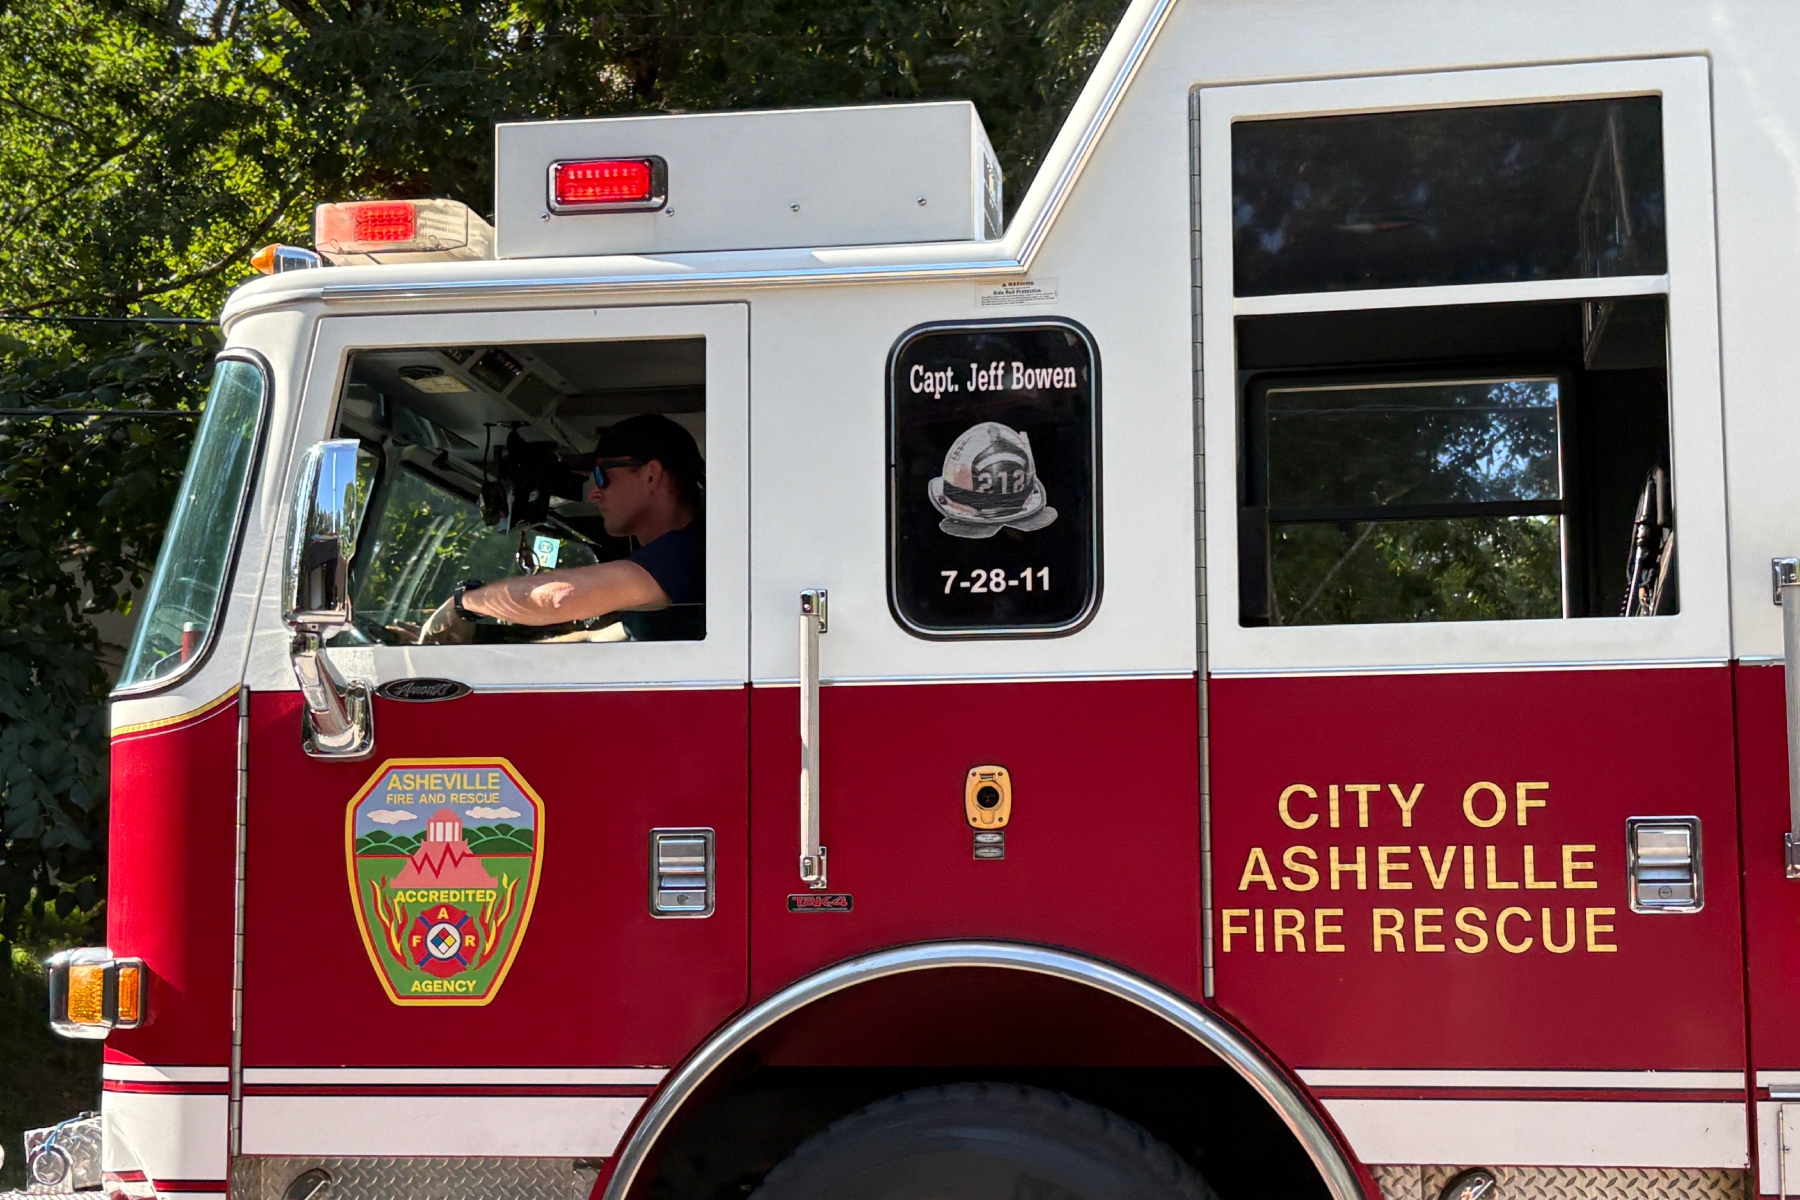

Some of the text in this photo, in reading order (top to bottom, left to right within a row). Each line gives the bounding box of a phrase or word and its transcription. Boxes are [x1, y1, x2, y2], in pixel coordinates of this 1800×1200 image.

[909, 361, 1077, 400] Capt. Jeff Bowen
[940, 566, 1050, 595] 7-28-11
[387, 773, 501, 791] ASHEVILLE
[386, 792, 500, 805] FIRE AND RESCUE
[1278, 781, 1550, 830] CITY OF
[1238, 844, 1598, 892] ASHEVILLE
[395, 889, 497, 904] ACCREDITED
[438, 907, 449, 919] A
[1221, 907, 1618, 954] FIRE RESCUE
[412, 934, 476, 947] F R
[410, 979, 477, 993] AGENCY
